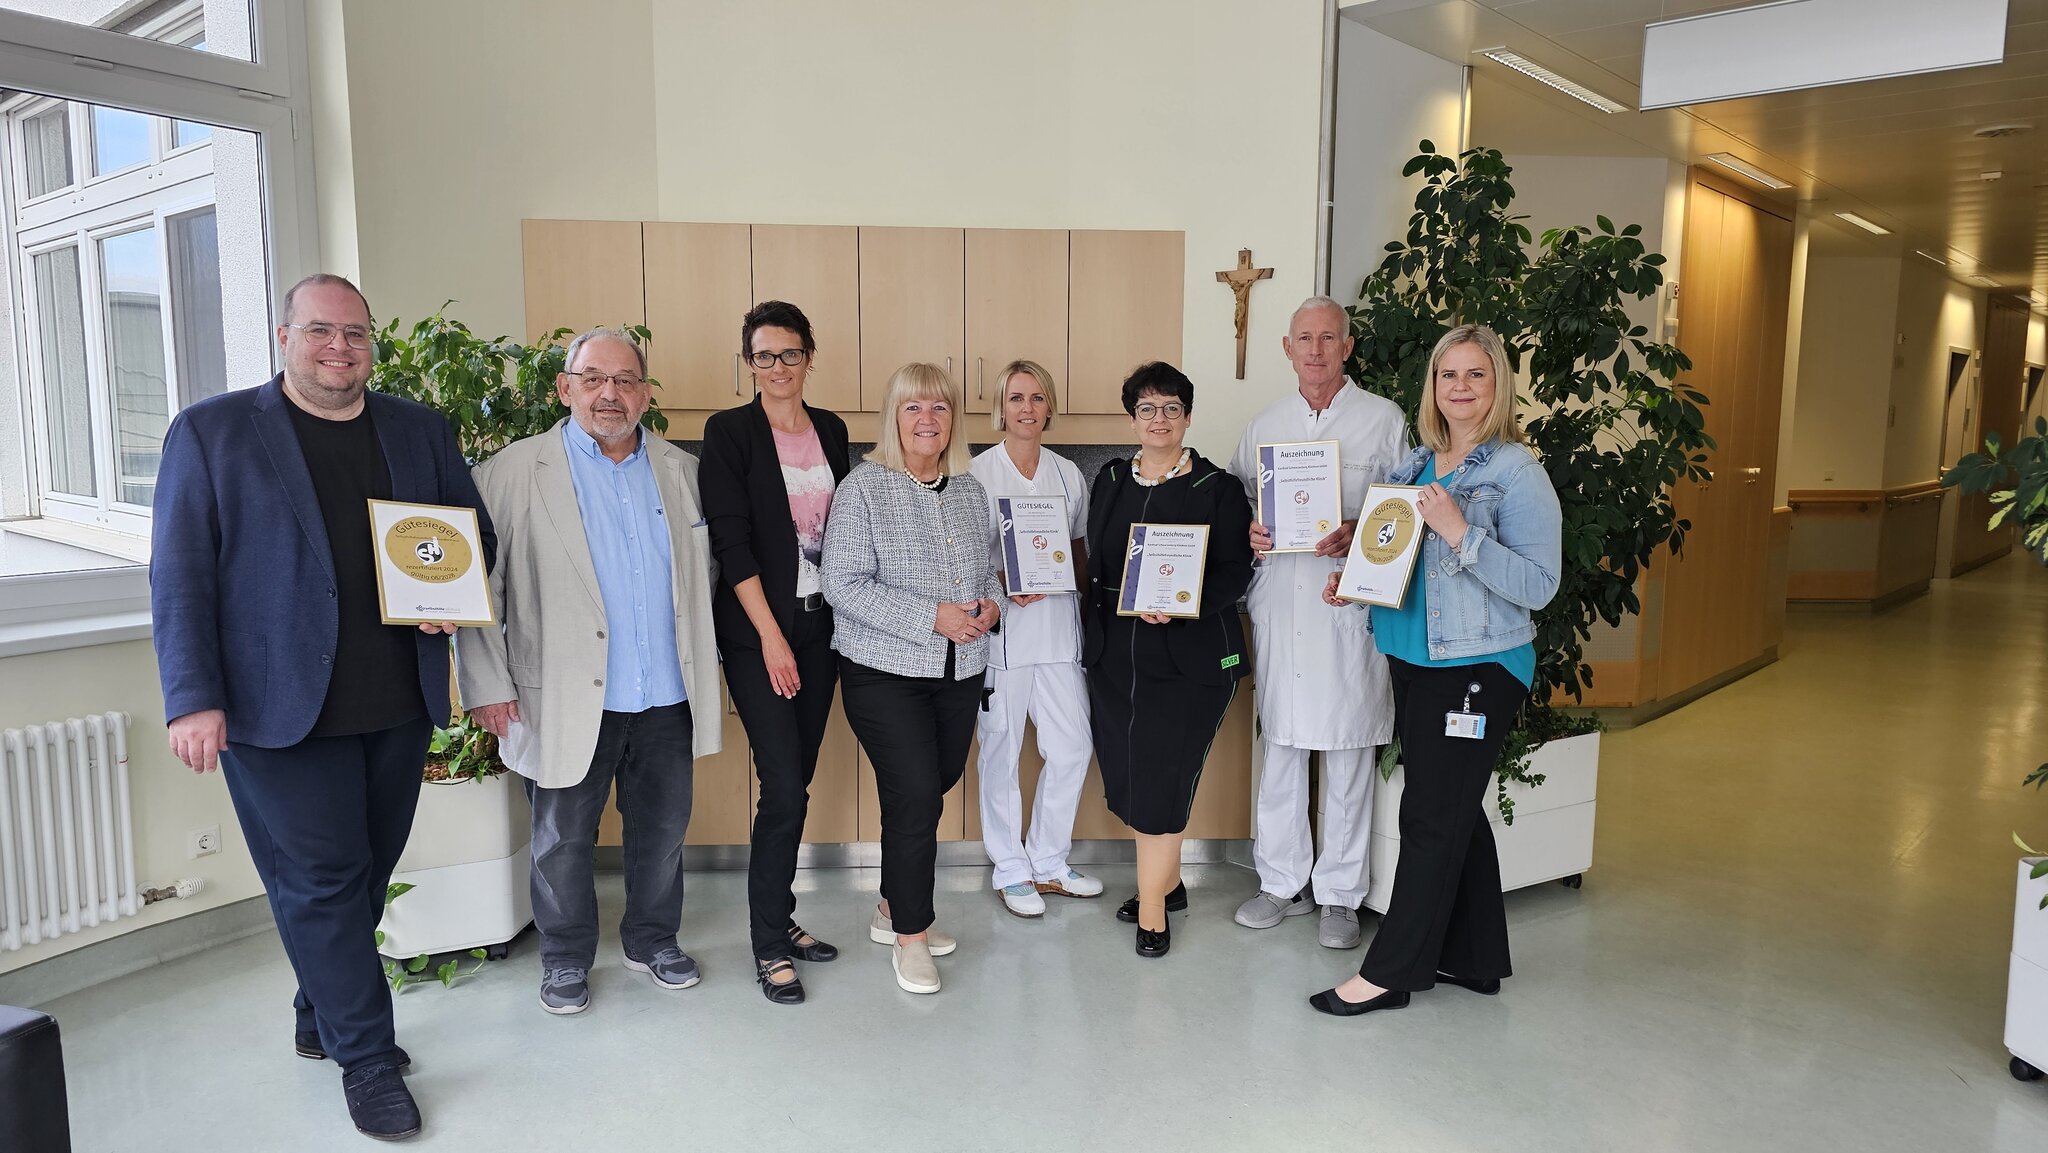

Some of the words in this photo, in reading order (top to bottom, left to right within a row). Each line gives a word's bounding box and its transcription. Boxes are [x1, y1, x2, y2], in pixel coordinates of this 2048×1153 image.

[1280, 450, 1324, 459] Auszeichnung
[1374, 502, 1413, 519] Gütesiegel
[395, 520, 458, 538] Gütesiegel
[1152, 531, 1194, 539] Auszeichnung
[410, 571, 430, 581] gültig
[1222, 655, 1239, 667] SILVER
